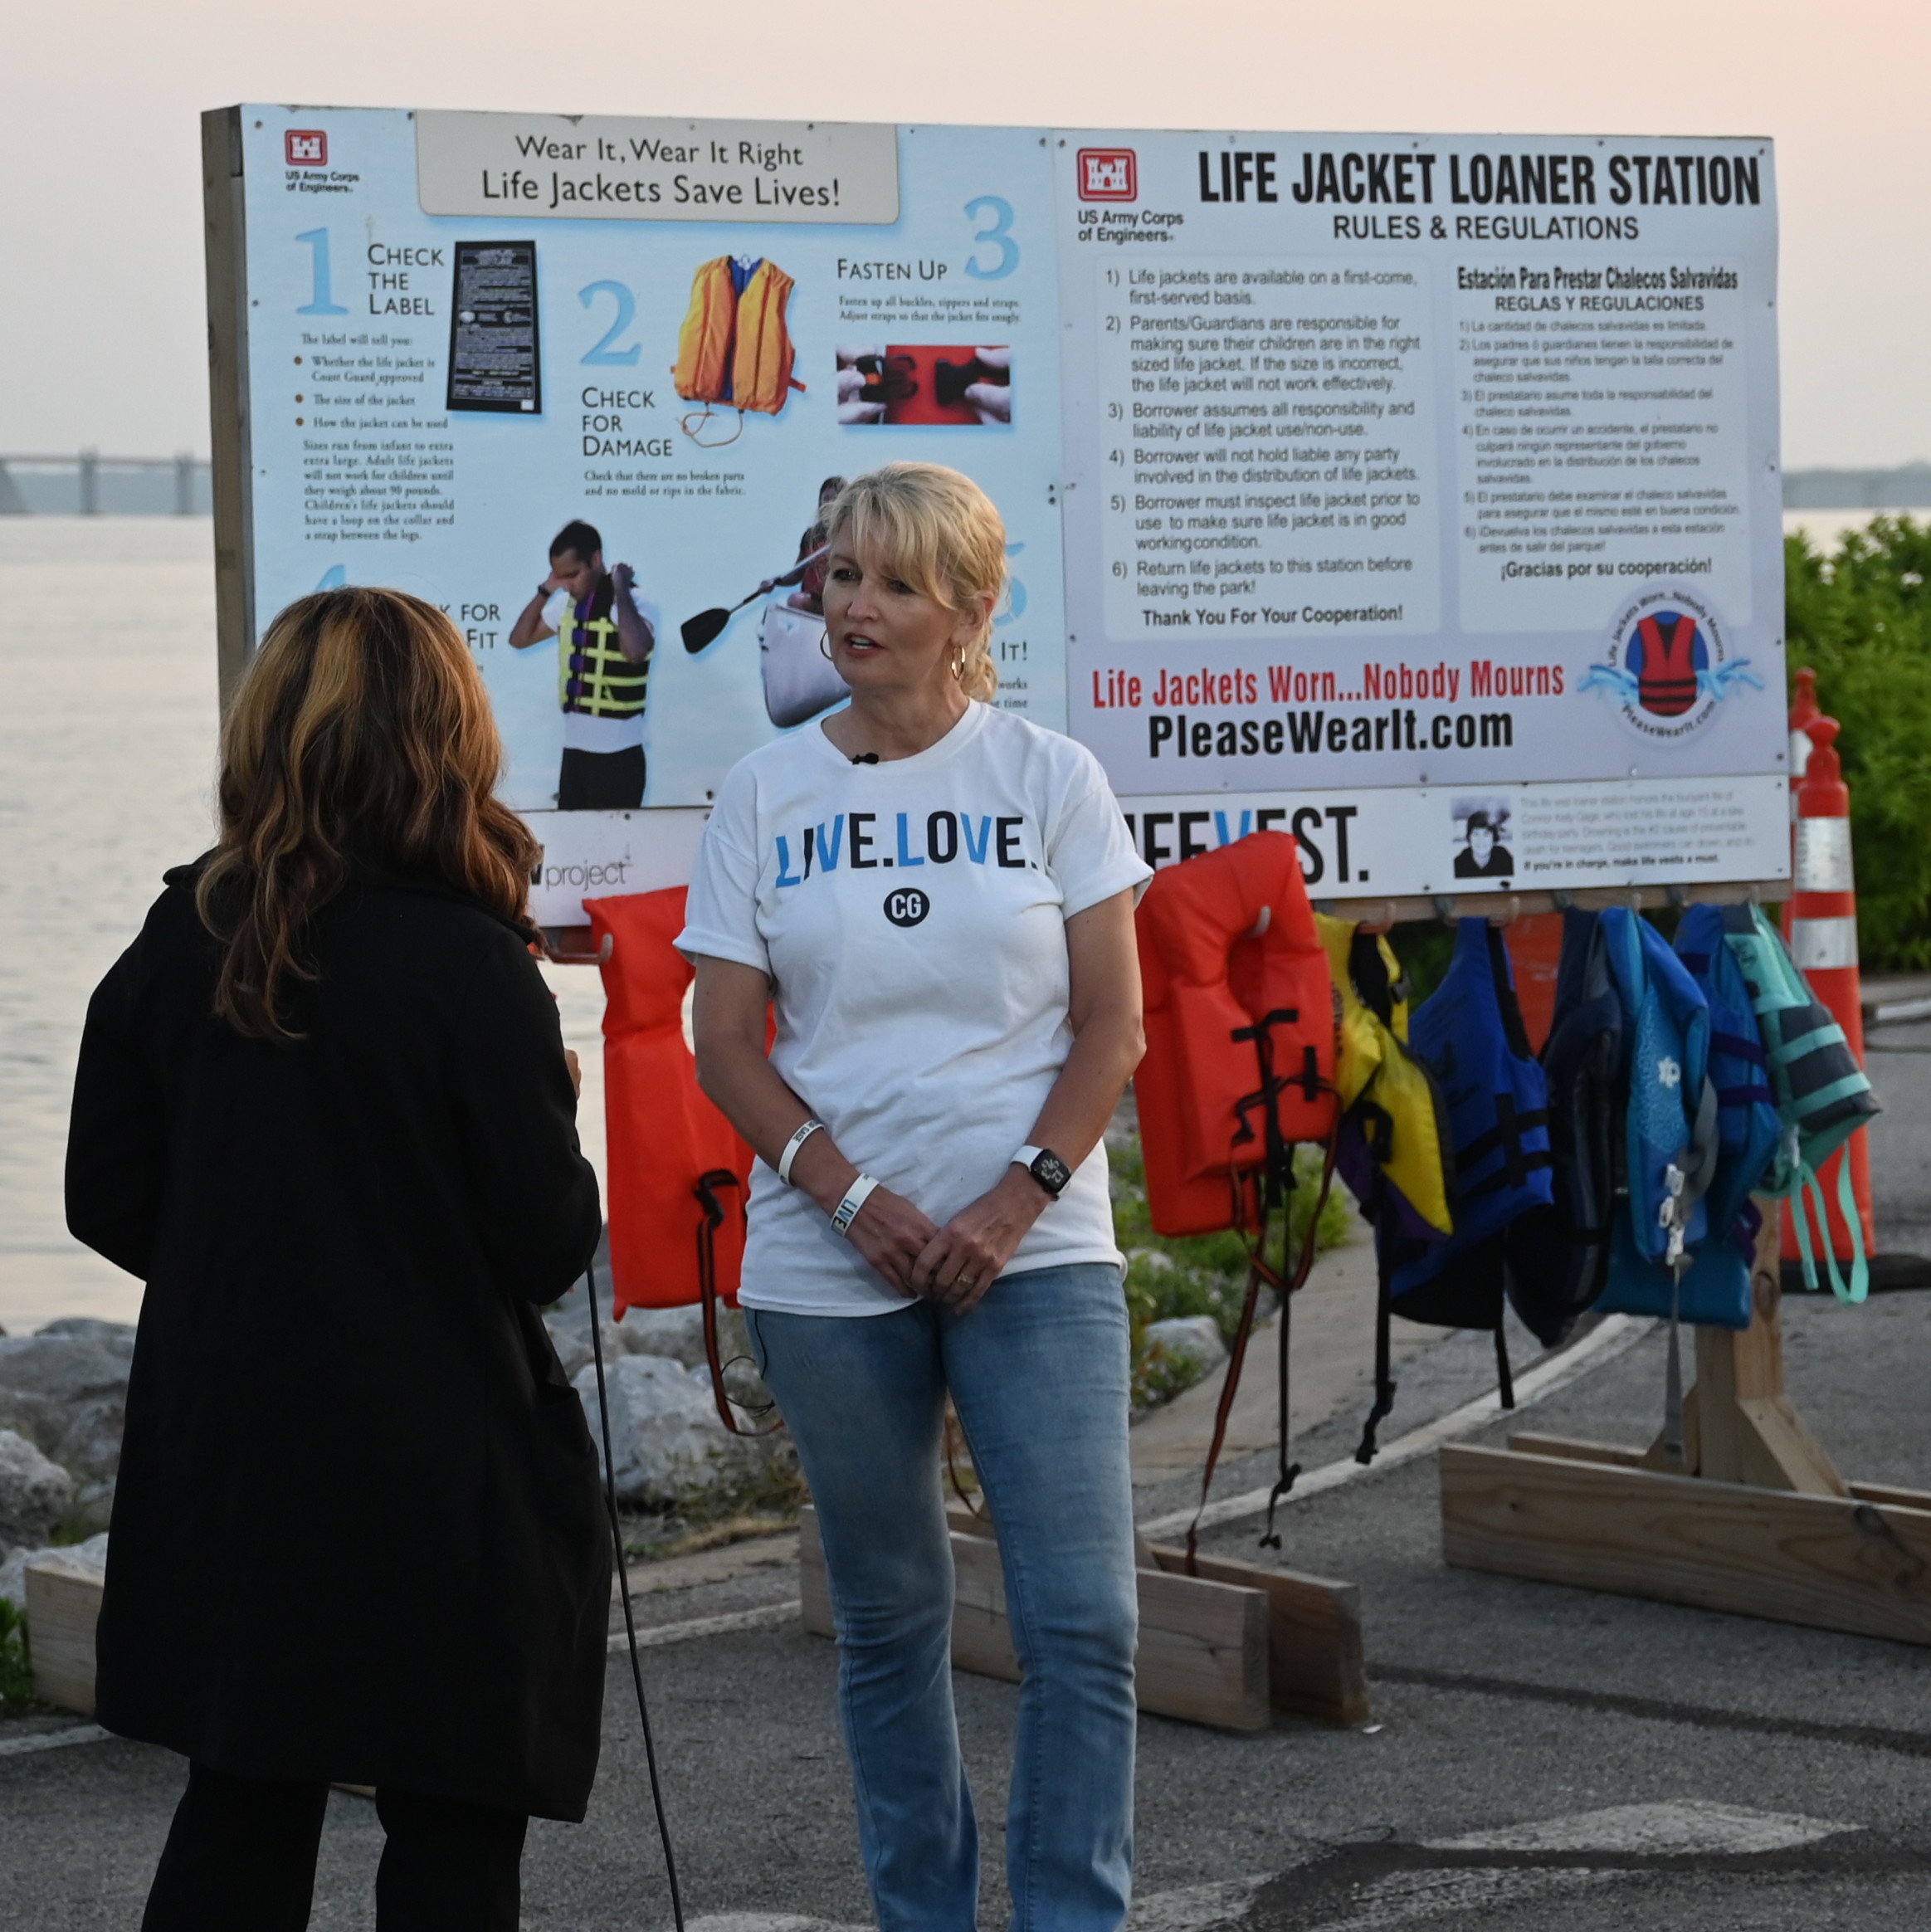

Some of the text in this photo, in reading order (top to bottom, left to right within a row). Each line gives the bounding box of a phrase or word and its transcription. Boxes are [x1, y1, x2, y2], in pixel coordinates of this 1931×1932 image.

[516, 134, 586, 159] Wear
[710, 140, 728, 163] It
[739, 141, 802, 172] Right
[285, 170, 360, 183] US Army Corps
[1199, 151, 1760, 206] LIFE JACKET LOANER STATION
[482, 169, 839, 209] Life Jackets Save Lives!
[1078, 209, 1184, 229] US Army Corps
[1334, 215, 1639, 240] RULES & REGULATIONS
[964, 195, 1021, 281] 3
[368, 244, 444, 266] CHECK
[295, 227, 349, 315] 1
[837, 258, 911, 280] FASTEN
[1107, 269, 1418, 288] 1) Life jackets are available on a first-come,
[1457, 266, 1738, 290] Estación Para Prestar Chalecos Salvavidas
[368, 272, 409, 290] THE
[368, 295, 435, 315] LABEL
[1129, 289, 1255, 305] first-served basis.
[1495, 295, 1704, 311] REGLAS Y REGULACIONES
[578, 280, 642, 366] 2
[1105, 315, 1400, 334] 2) Parents/Guardians are responsible for
[1130, 336, 1421, 355] making sure their children are in the right
[582, 387, 656, 408] CHECK
[1109, 401, 1415, 421] 3) Borrower assumes all responsibility and
[583, 415, 623, 432] FOR
[1133, 422, 1367, 442] liability of life jacket use/non-use.
[583, 436, 673, 456] DAMAGE
[1112, 556, 1412, 579] 6) Return life jackets to this station before
[1501, 558, 1712, 581] ¡Gracias por su cooperación!
[1137, 580, 1256, 601] leaving the park!
[461, 603, 500, 622] FOR
[1143, 604, 1402, 627] Thank You For Your Cooperation!
[1093, 670, 1142, 709] Life
[1153, 666, 1258, 707] Jackets
[1470, 661, 1564, 697] Mourns
[1148, 709, 1513, 759] PleaseWearIt.com
[546, 859, 627, 892] project
[891, 892, 922, 920] CG
